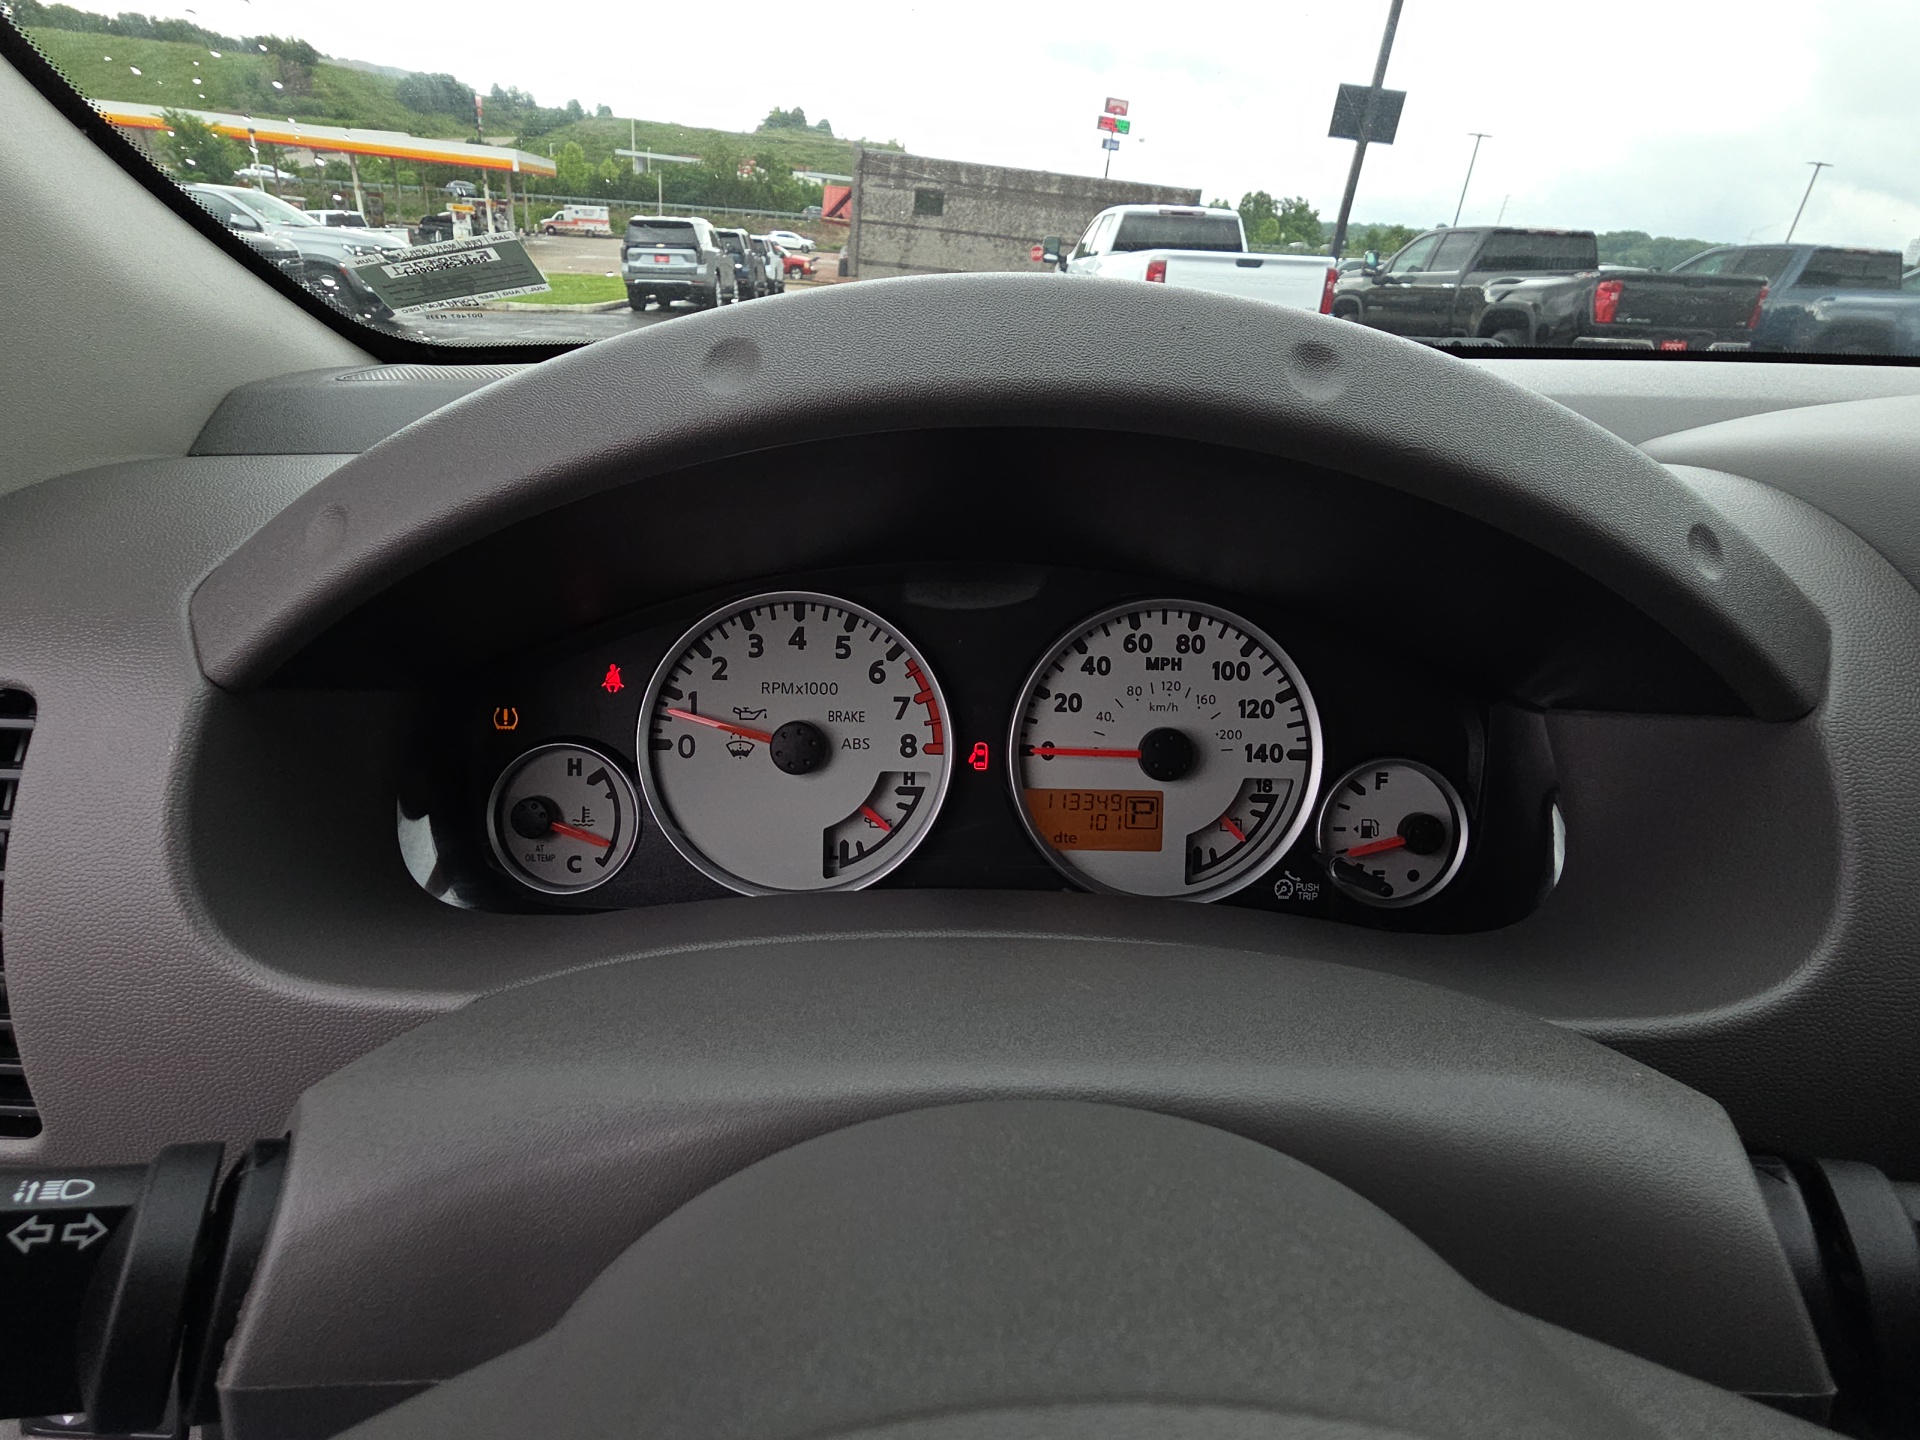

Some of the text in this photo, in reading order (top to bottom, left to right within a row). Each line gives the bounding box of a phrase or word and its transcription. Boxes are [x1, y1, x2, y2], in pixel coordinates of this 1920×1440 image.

[748, 634, 764, 658] 3
[788, 626, 807, 650] 4
[1123, 633, 1152, 654] 60
[1175, 634, 1206, 654] 80
[835, 636, 851, 659] 5
[711, 656, 728, 681] 2
[868, 660, 886, 684] 6
[1081, 656, 1111, 676] 40
[1145, 657, 1182, 671] MPH
[1212, 661, 1250, 681] 100
[761, 682, 838, 696] RPMx1000
[1126, 686, 1143, 697] 80
[1161, 681, 1182, 692] 120
[687, 691, 698, 715] 1
[893, 697, 911, 720] 7
[1054, 693, 1083, 713] 20
[1149, 702, 1179, 713] km/h
[1196, 694, 1216, 705] 160
[827, 710, 866, 723] BRAKE
[1096, 712, 1111, 722] 40
[1238, 699, 1275, 719] 120
[1219, 729, 1243, 740] 200
[678, 734, 696, 759] 0
[841, 738, 870, 750] ABS
[899, 734, 917, 758] 8
[1244, 744, 1284, 763] 140
[567, 758, 583, 777] H
[903, 772, 916, 785] H
[1255, 779, 1273, 793] 18
[1375, 772, 1389, 790] F
[1049, 793, 1122, 811] 113349
[1129, 799, 1155, 825] P
[1090, 814, 1122, 831] 101
[1053, 831, 1078, 844] dte
[525, 854, 556, 862] OIL TEMP
[535, 845, 545, 853] AT
[567, 855, 582, 873] C
[1296, 882, 1320, 892] PUSH
[1297, 891, 1318, 901] TRIP
